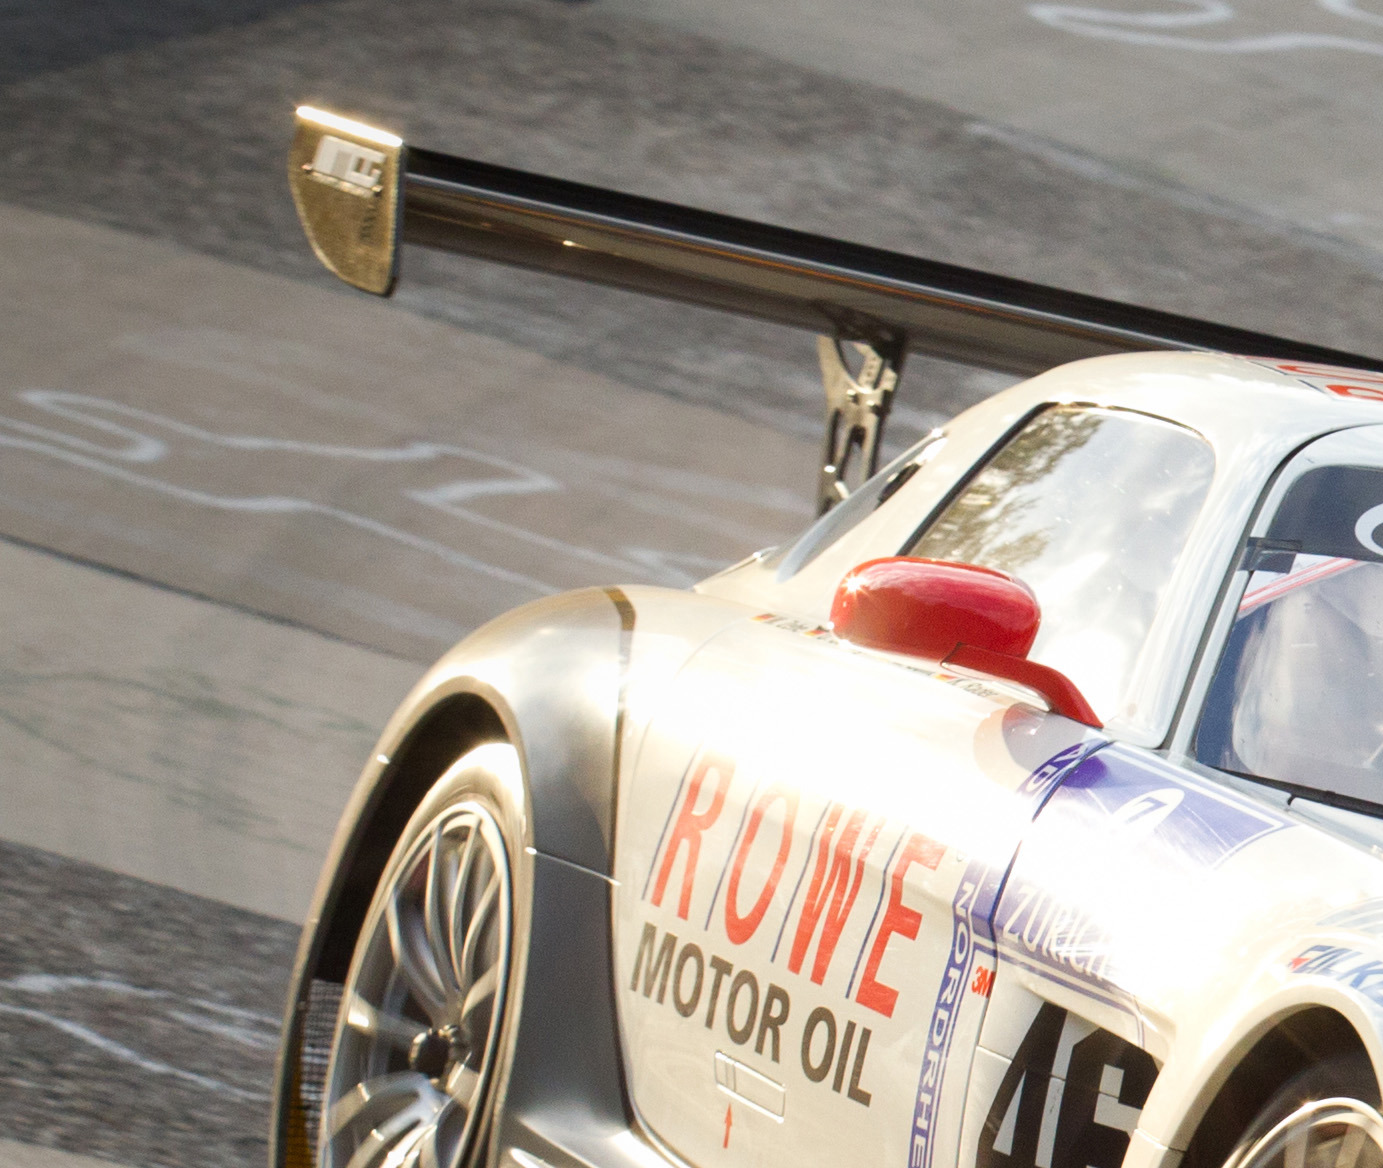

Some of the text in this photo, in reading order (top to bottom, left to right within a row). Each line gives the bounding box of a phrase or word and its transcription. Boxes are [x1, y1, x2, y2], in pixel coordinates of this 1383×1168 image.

[650, 748, 952, 1019] ROWE
[630, 921, 874, 1108] MOTOR OIL
[970, 965, 996, 998] 3M
